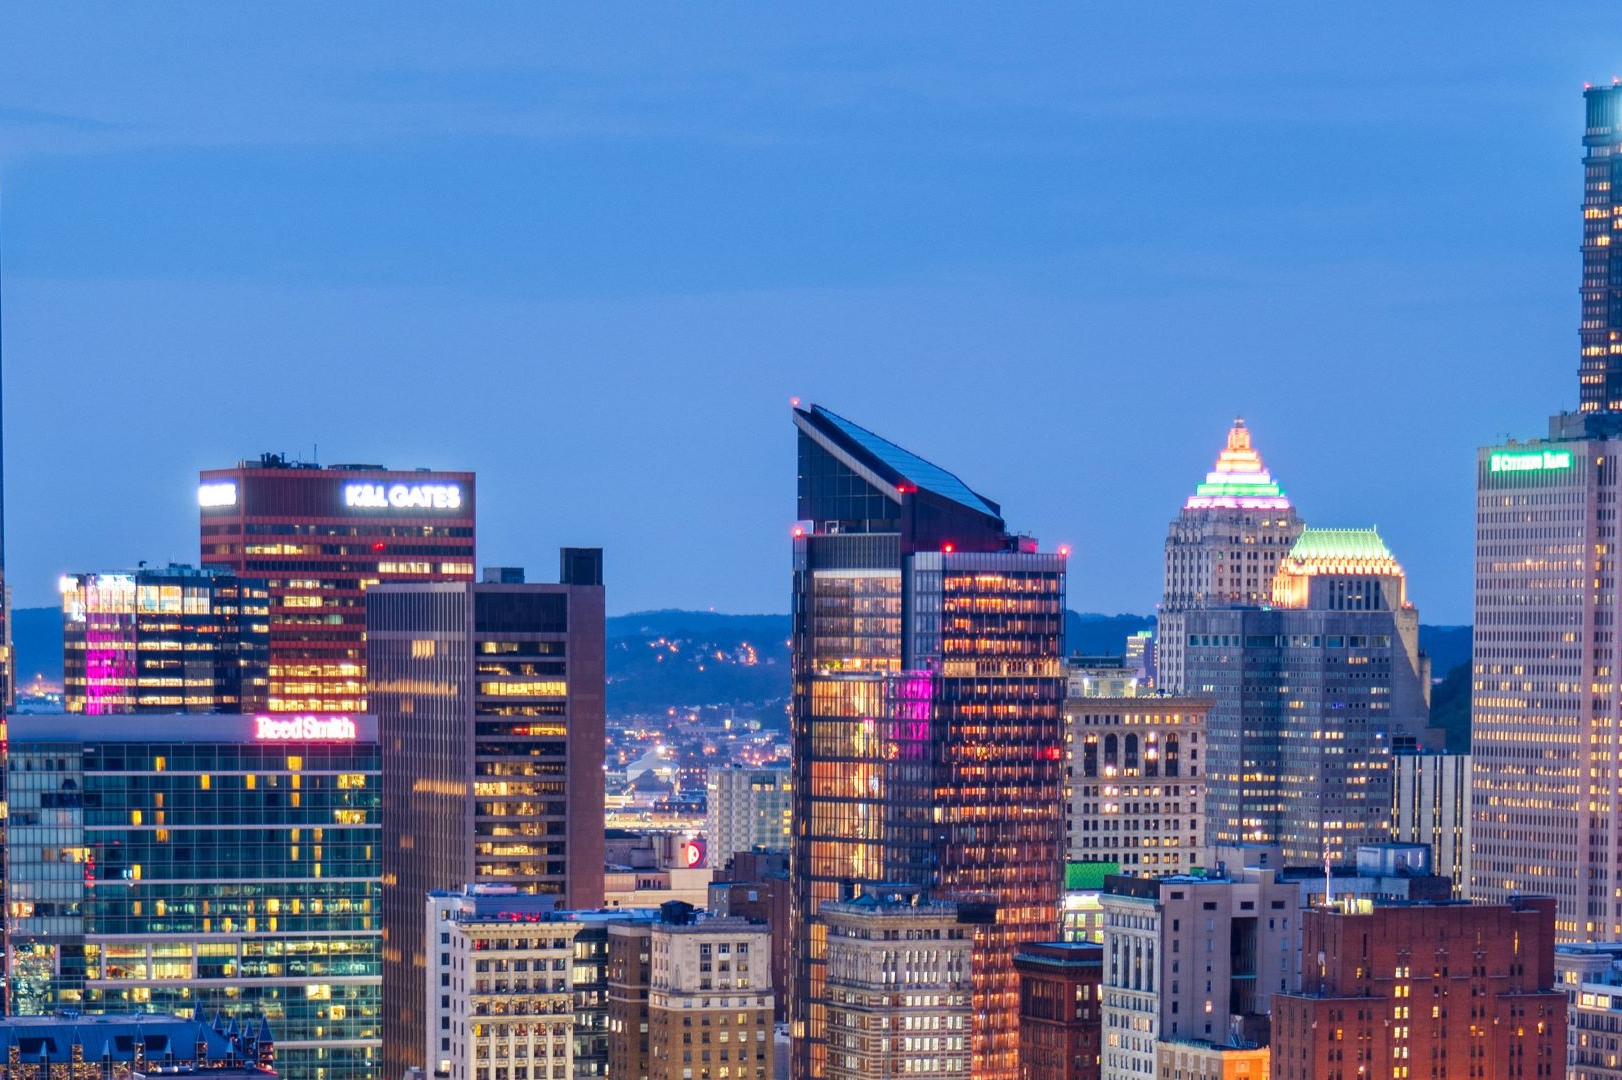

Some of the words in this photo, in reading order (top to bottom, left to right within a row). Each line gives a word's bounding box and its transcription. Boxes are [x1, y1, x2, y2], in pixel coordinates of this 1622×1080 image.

[388, 484, 461, 508] GATES
[256, 716, 303, 740] Reed
[303, 716, 356, 740] Smith
